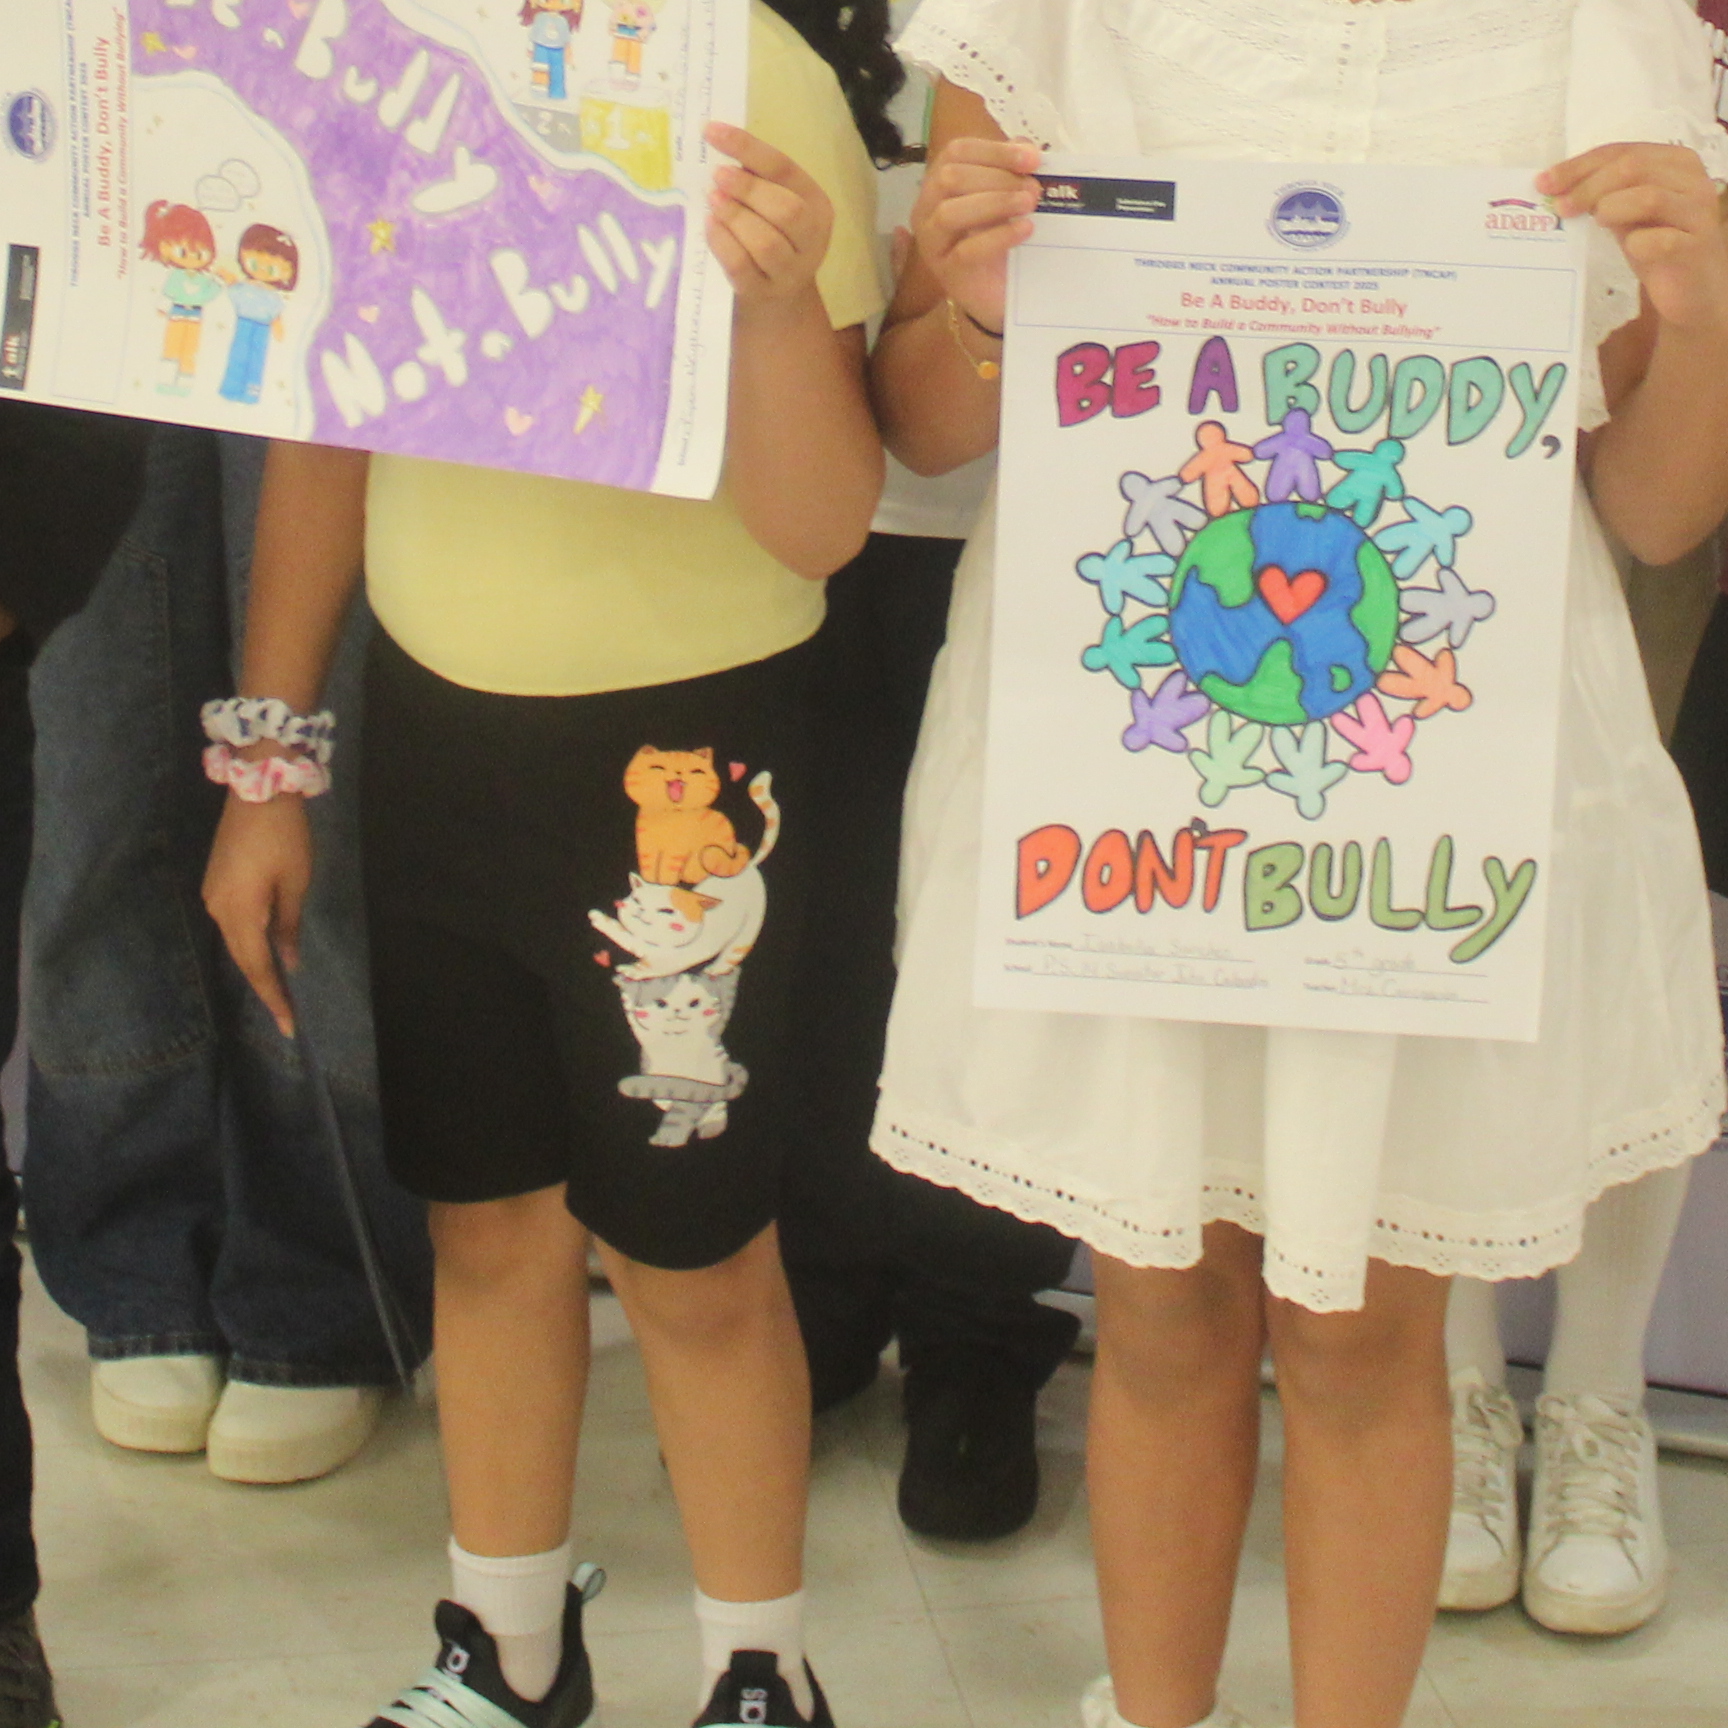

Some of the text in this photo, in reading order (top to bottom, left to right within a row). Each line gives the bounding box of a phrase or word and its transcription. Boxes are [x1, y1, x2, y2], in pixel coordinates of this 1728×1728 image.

[93, 36, 110, 79] Bully
[98, 207, 110, 219] A
[97, 225, 110, 246] Be
[320, 286, 467, 430] Not
[489, 211, 676, 340] Bully
[1180, 292, 1204, 308] Be
[1210, 293, 1223, 308] A
[1359, 298, 1406, 318] Bully
[1056, 336, 1568, 459] BE A BUDDY,
[1015, 816, 1538, 964] DON'T BULLY
